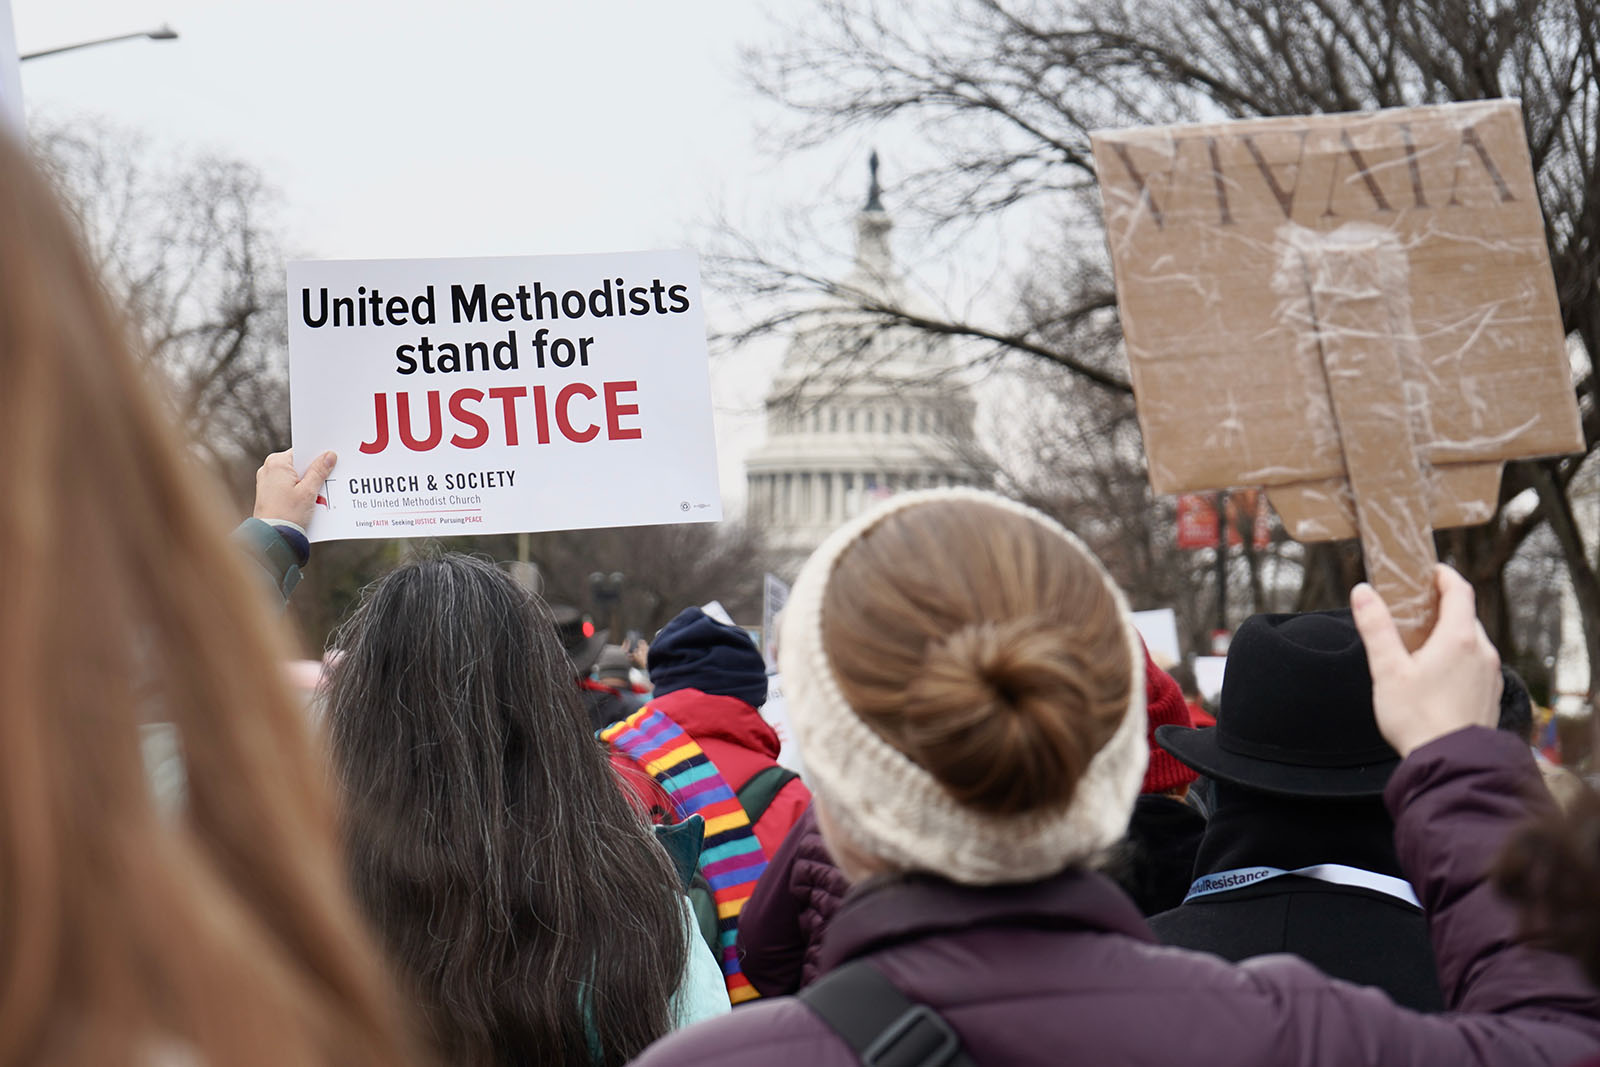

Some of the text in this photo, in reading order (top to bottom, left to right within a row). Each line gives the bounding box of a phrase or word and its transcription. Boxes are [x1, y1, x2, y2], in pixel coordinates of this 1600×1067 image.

[302, 278, 690, 329] United Methodists
[395, 329, 595, 375] stand for
[359, 380, 643, 455] JUSTICE
[349, 470, 517, 495] CHURCH & SOCIETY
[352, 494, 482, 509] The United Methodist Church
